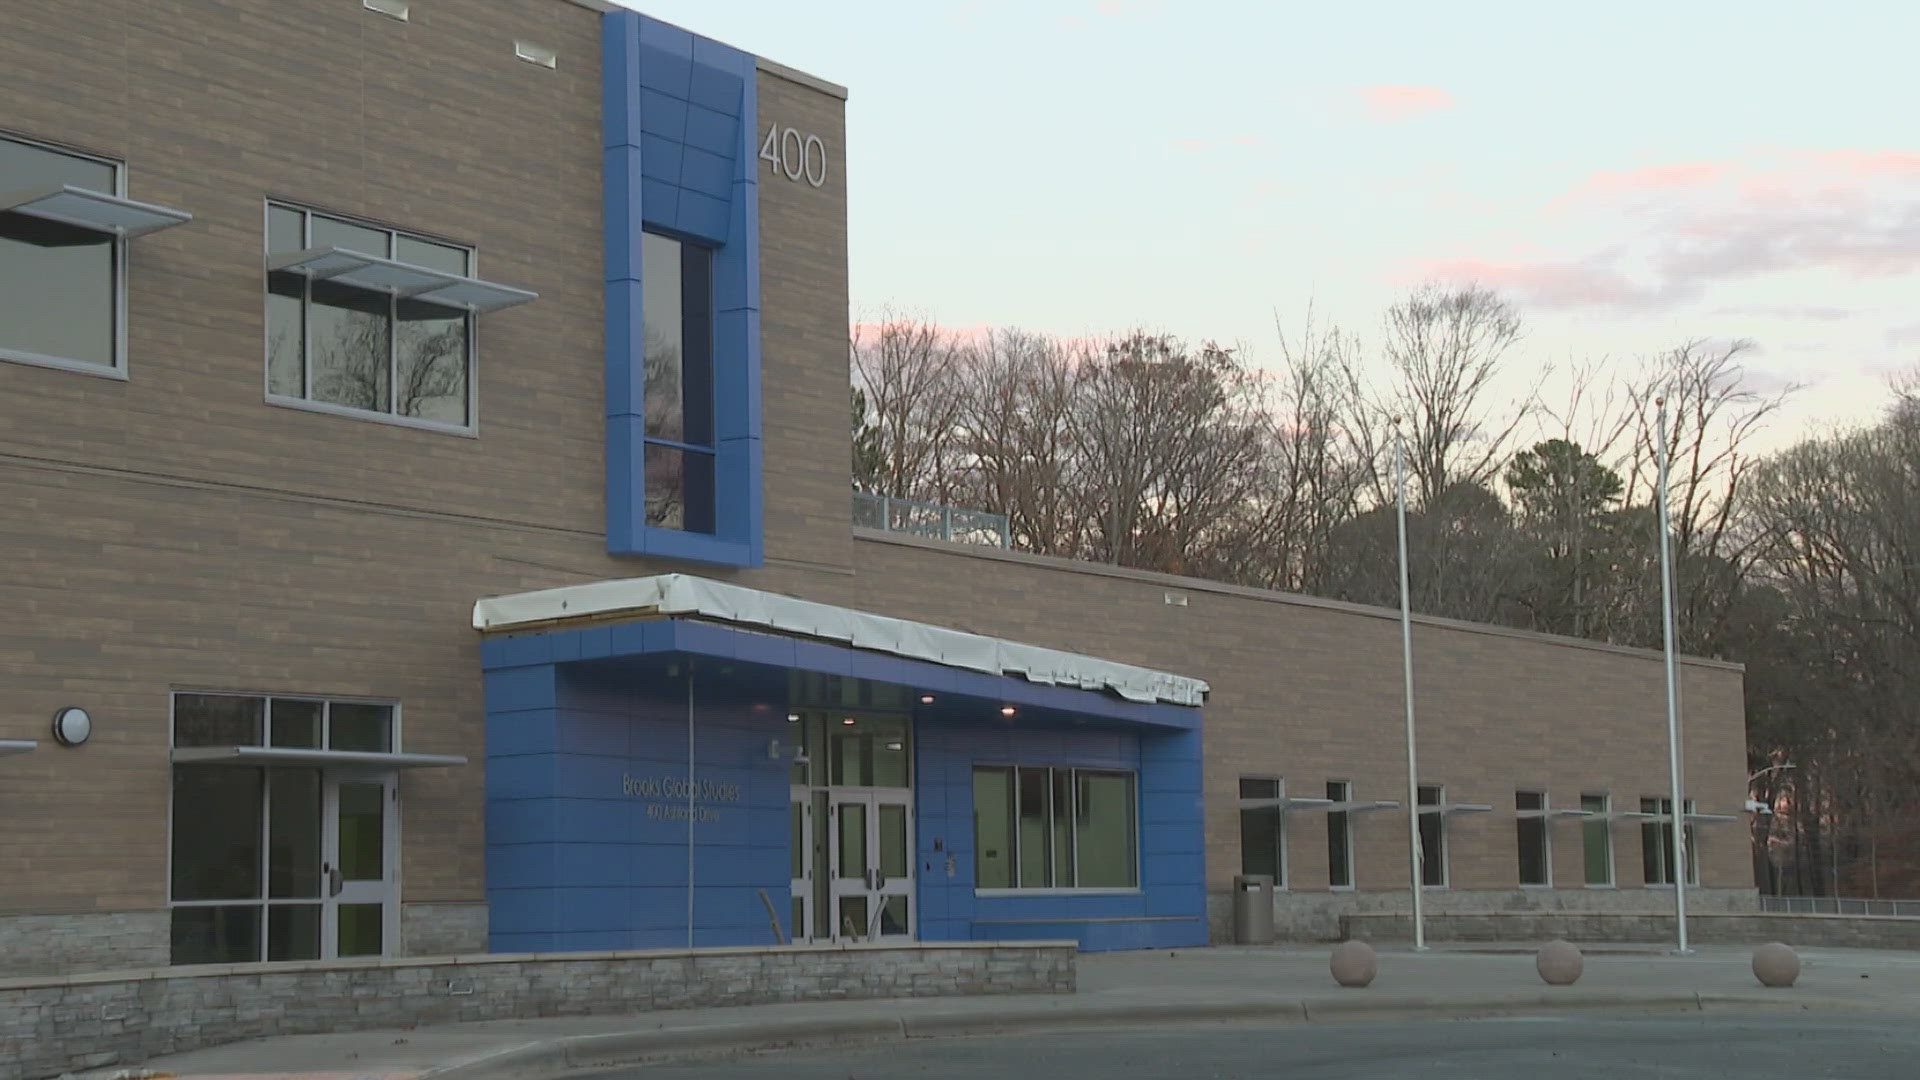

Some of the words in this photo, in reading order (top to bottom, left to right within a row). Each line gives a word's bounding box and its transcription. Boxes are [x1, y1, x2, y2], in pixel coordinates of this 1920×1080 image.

[759, 122, 826, 188] 400
[623, 773, 660, 797] Brooks
[702, 778, 740, 801] Studies
